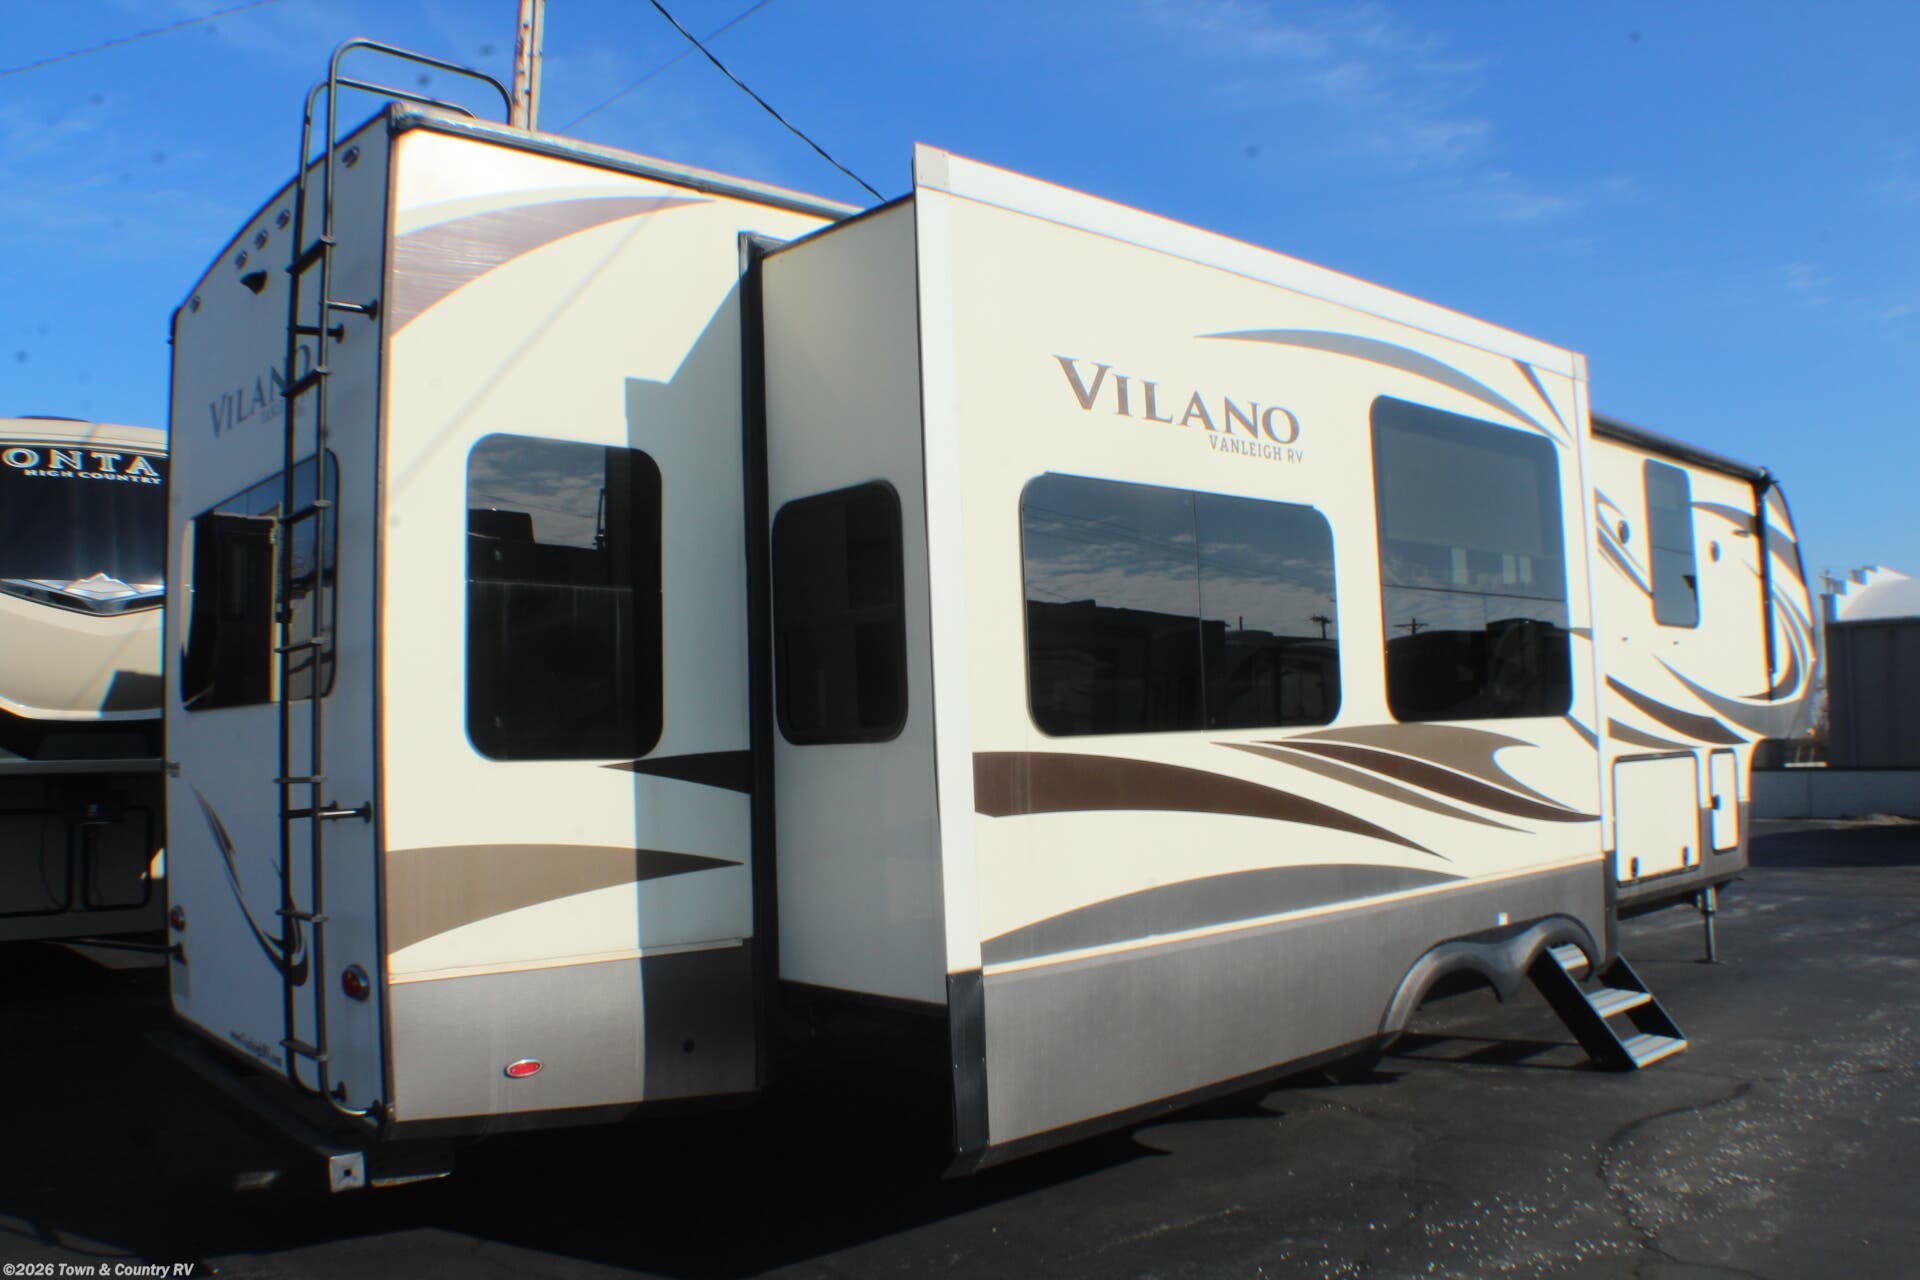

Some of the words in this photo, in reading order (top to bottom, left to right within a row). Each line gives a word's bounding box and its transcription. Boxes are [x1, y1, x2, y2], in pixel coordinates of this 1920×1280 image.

[1052, 354, 1300, 444] VILANO
[1209, 433, 1283, 461] VANLEIGH
[1287, 448, 1304, 463] RV
[24, 469, 75, 478] HIGH
[77, 471, 163, 485] COUNTRY
